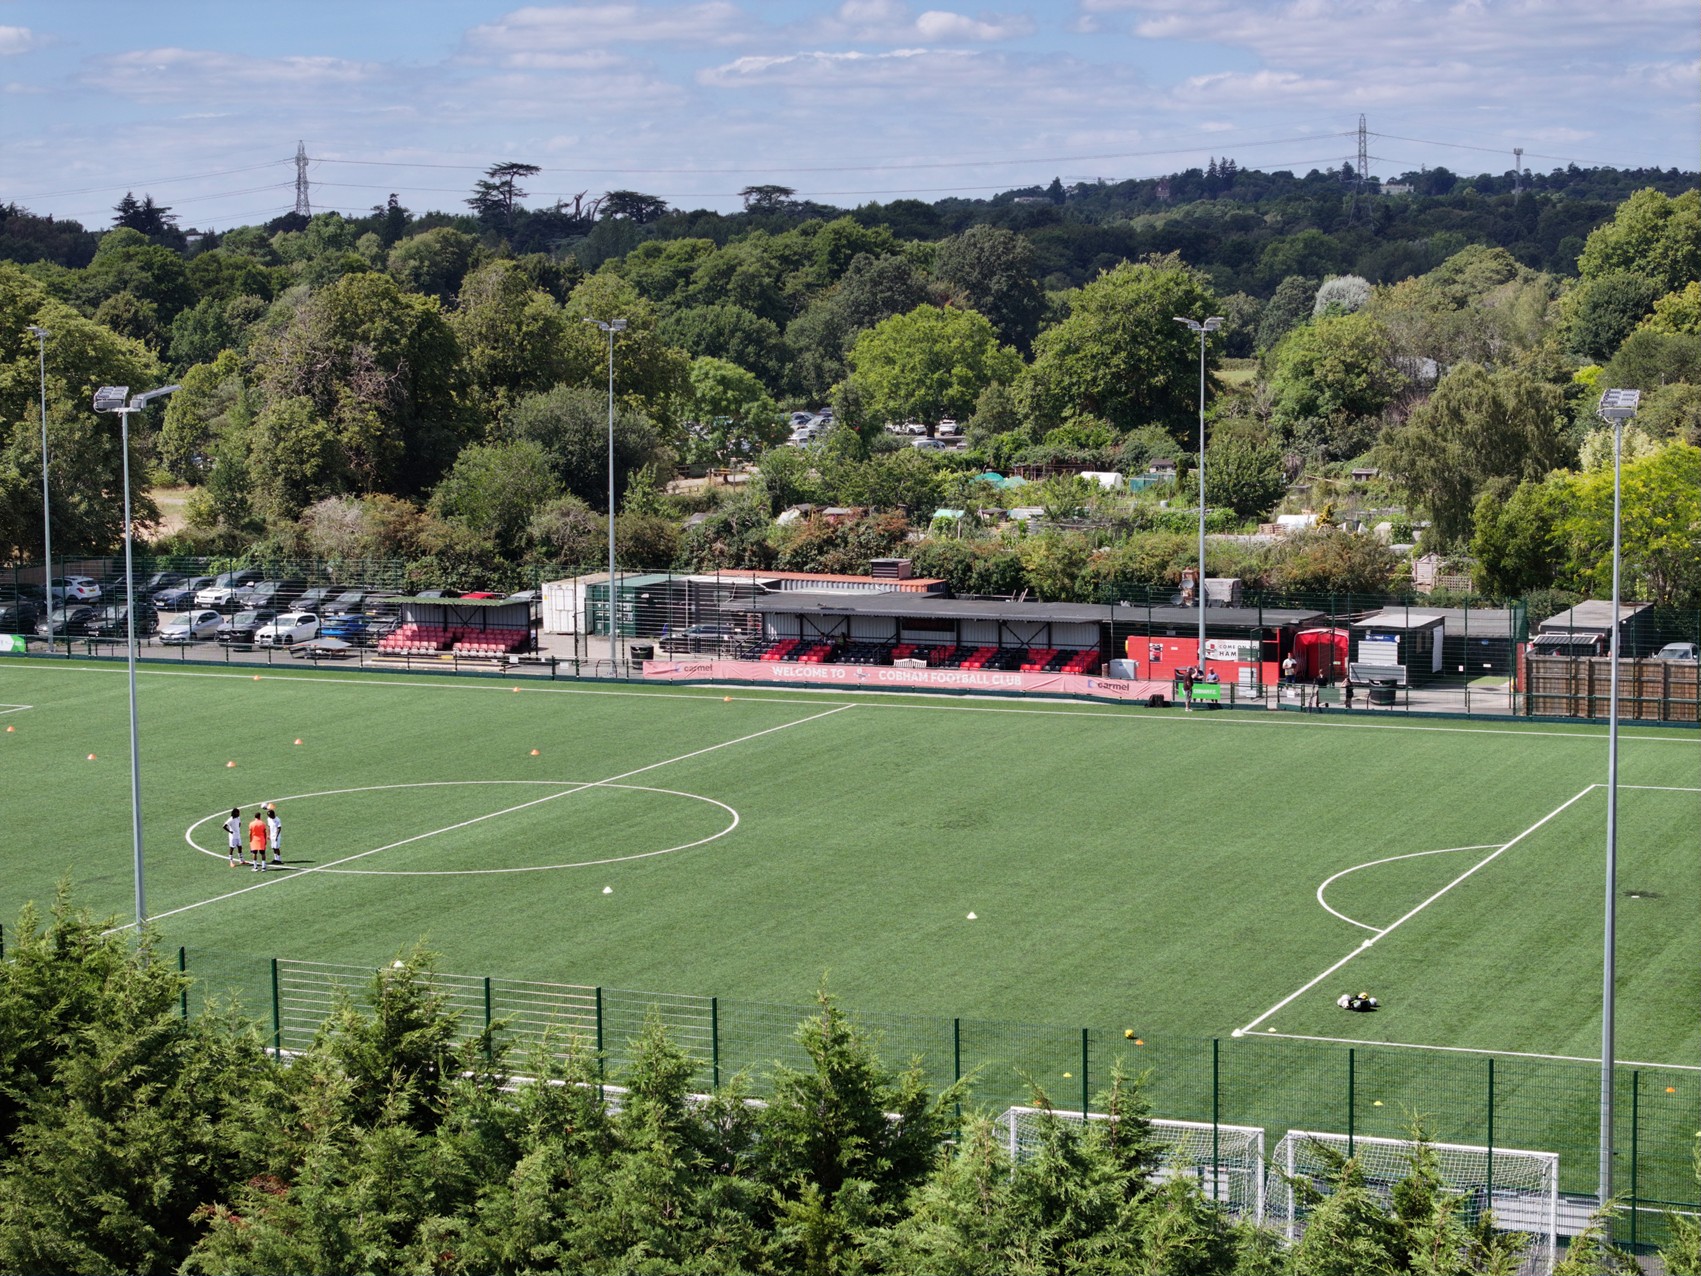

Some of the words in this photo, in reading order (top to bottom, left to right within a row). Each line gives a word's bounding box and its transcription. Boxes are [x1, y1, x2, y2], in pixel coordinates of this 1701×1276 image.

[772, 666, 828, 678] WELCOME
[830, 668, 846, 679] TO
[878, 670, 928, 683] COBHAM
[931, 672, 989, 685] FOOTBALL
[992, 674, 1022, 686] CLUB
[1097, 680, 1130, 691] carmel
